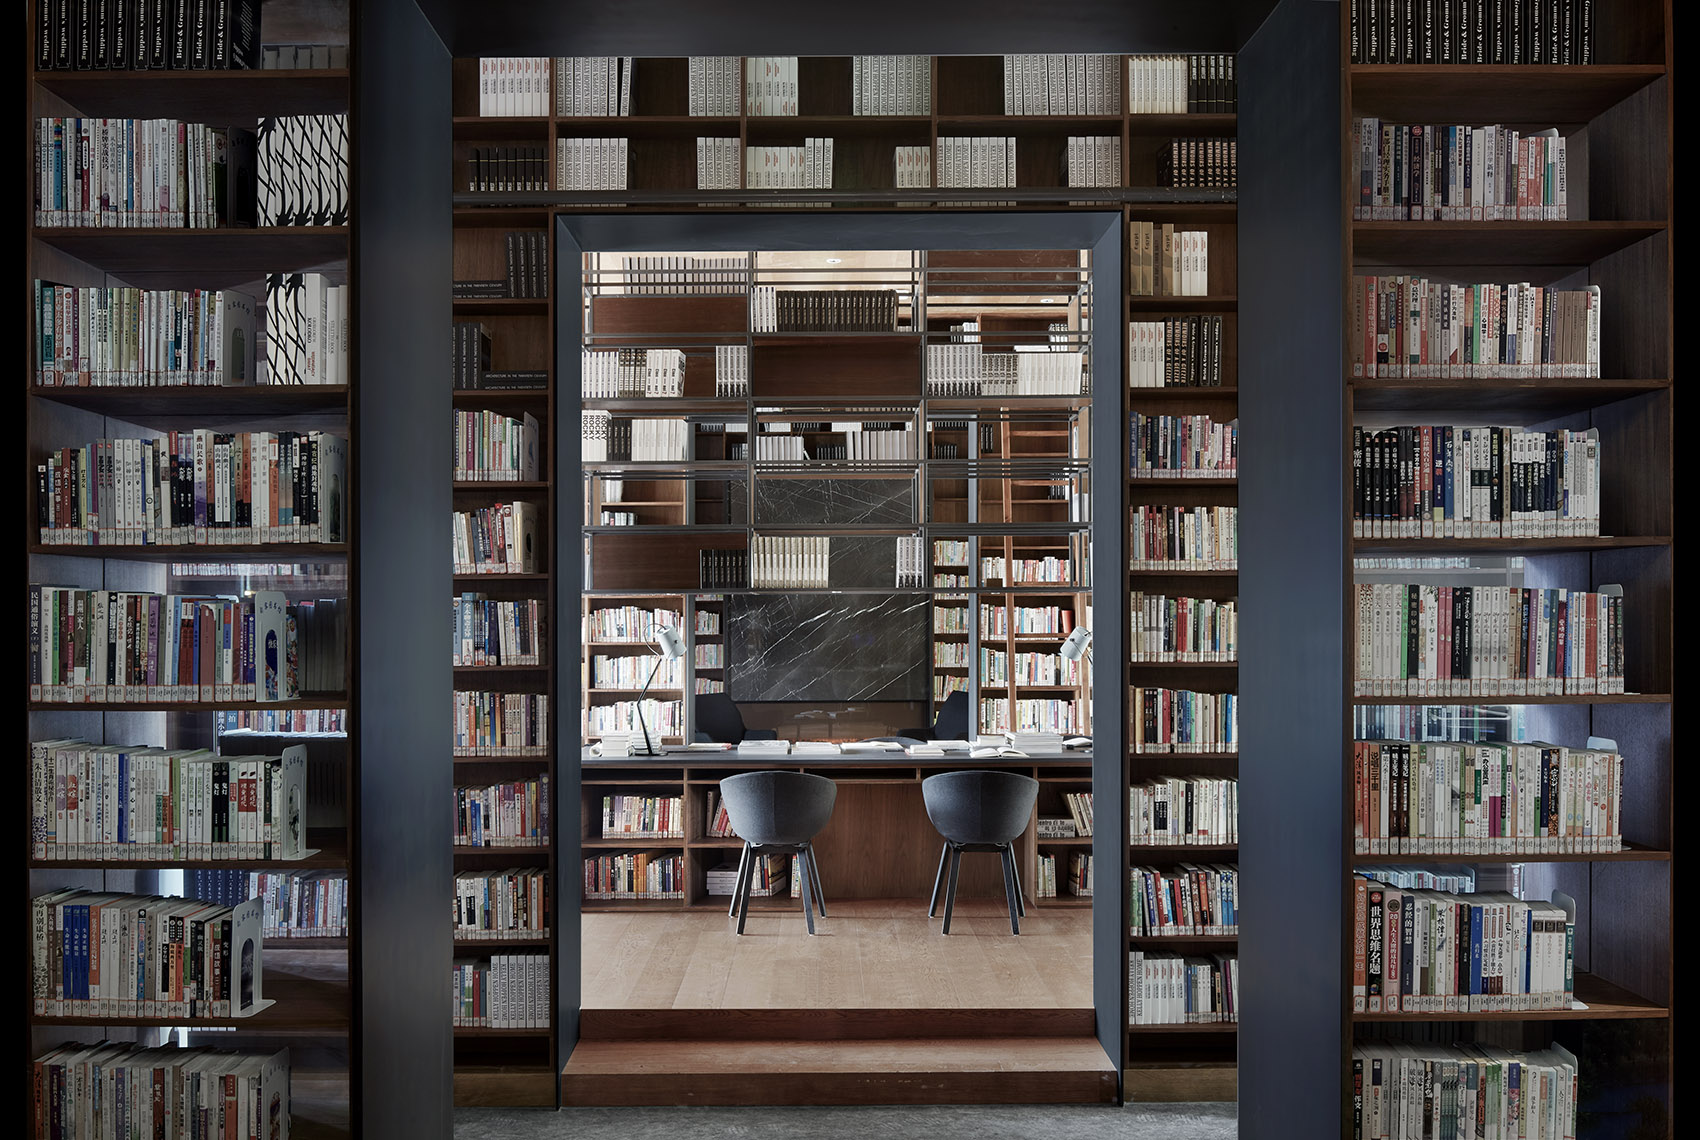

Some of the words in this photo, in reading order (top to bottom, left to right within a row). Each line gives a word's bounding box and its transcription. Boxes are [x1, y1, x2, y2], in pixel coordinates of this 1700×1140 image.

[60, 26, 68, 58] wedding
[116, 25, 124, 58] wedding
[155, 24, 163, 57] wedding
[176, 37, 185, 59] Bride
[196, 38, 204, 59] Bride
[217, 38, 225, 60] Bride
[196, 435, 204, 465] 燕山长歌
[1371, 751, 1379, 791] 说三千里
[36, 909, 44, 941] 再别康桥
[1369, 905, 1383, 975] 世界思维名题
